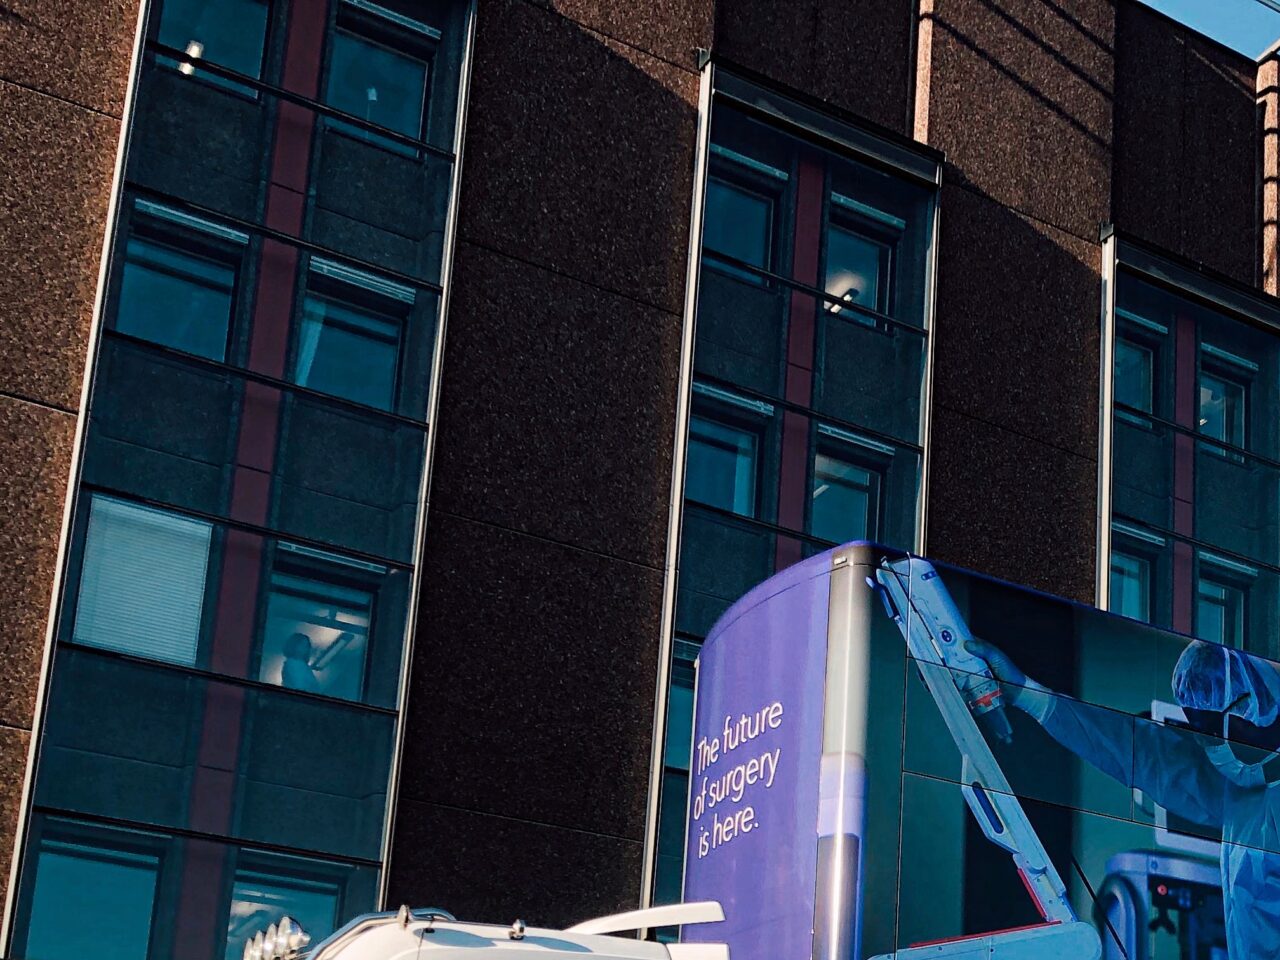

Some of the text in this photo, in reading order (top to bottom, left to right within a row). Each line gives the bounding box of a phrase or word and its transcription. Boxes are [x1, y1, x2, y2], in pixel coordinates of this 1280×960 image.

[697, 702, 783, 776] The future
[694, 749, 781, 820] of surgery
[699, 805, 759, 859] is here.
